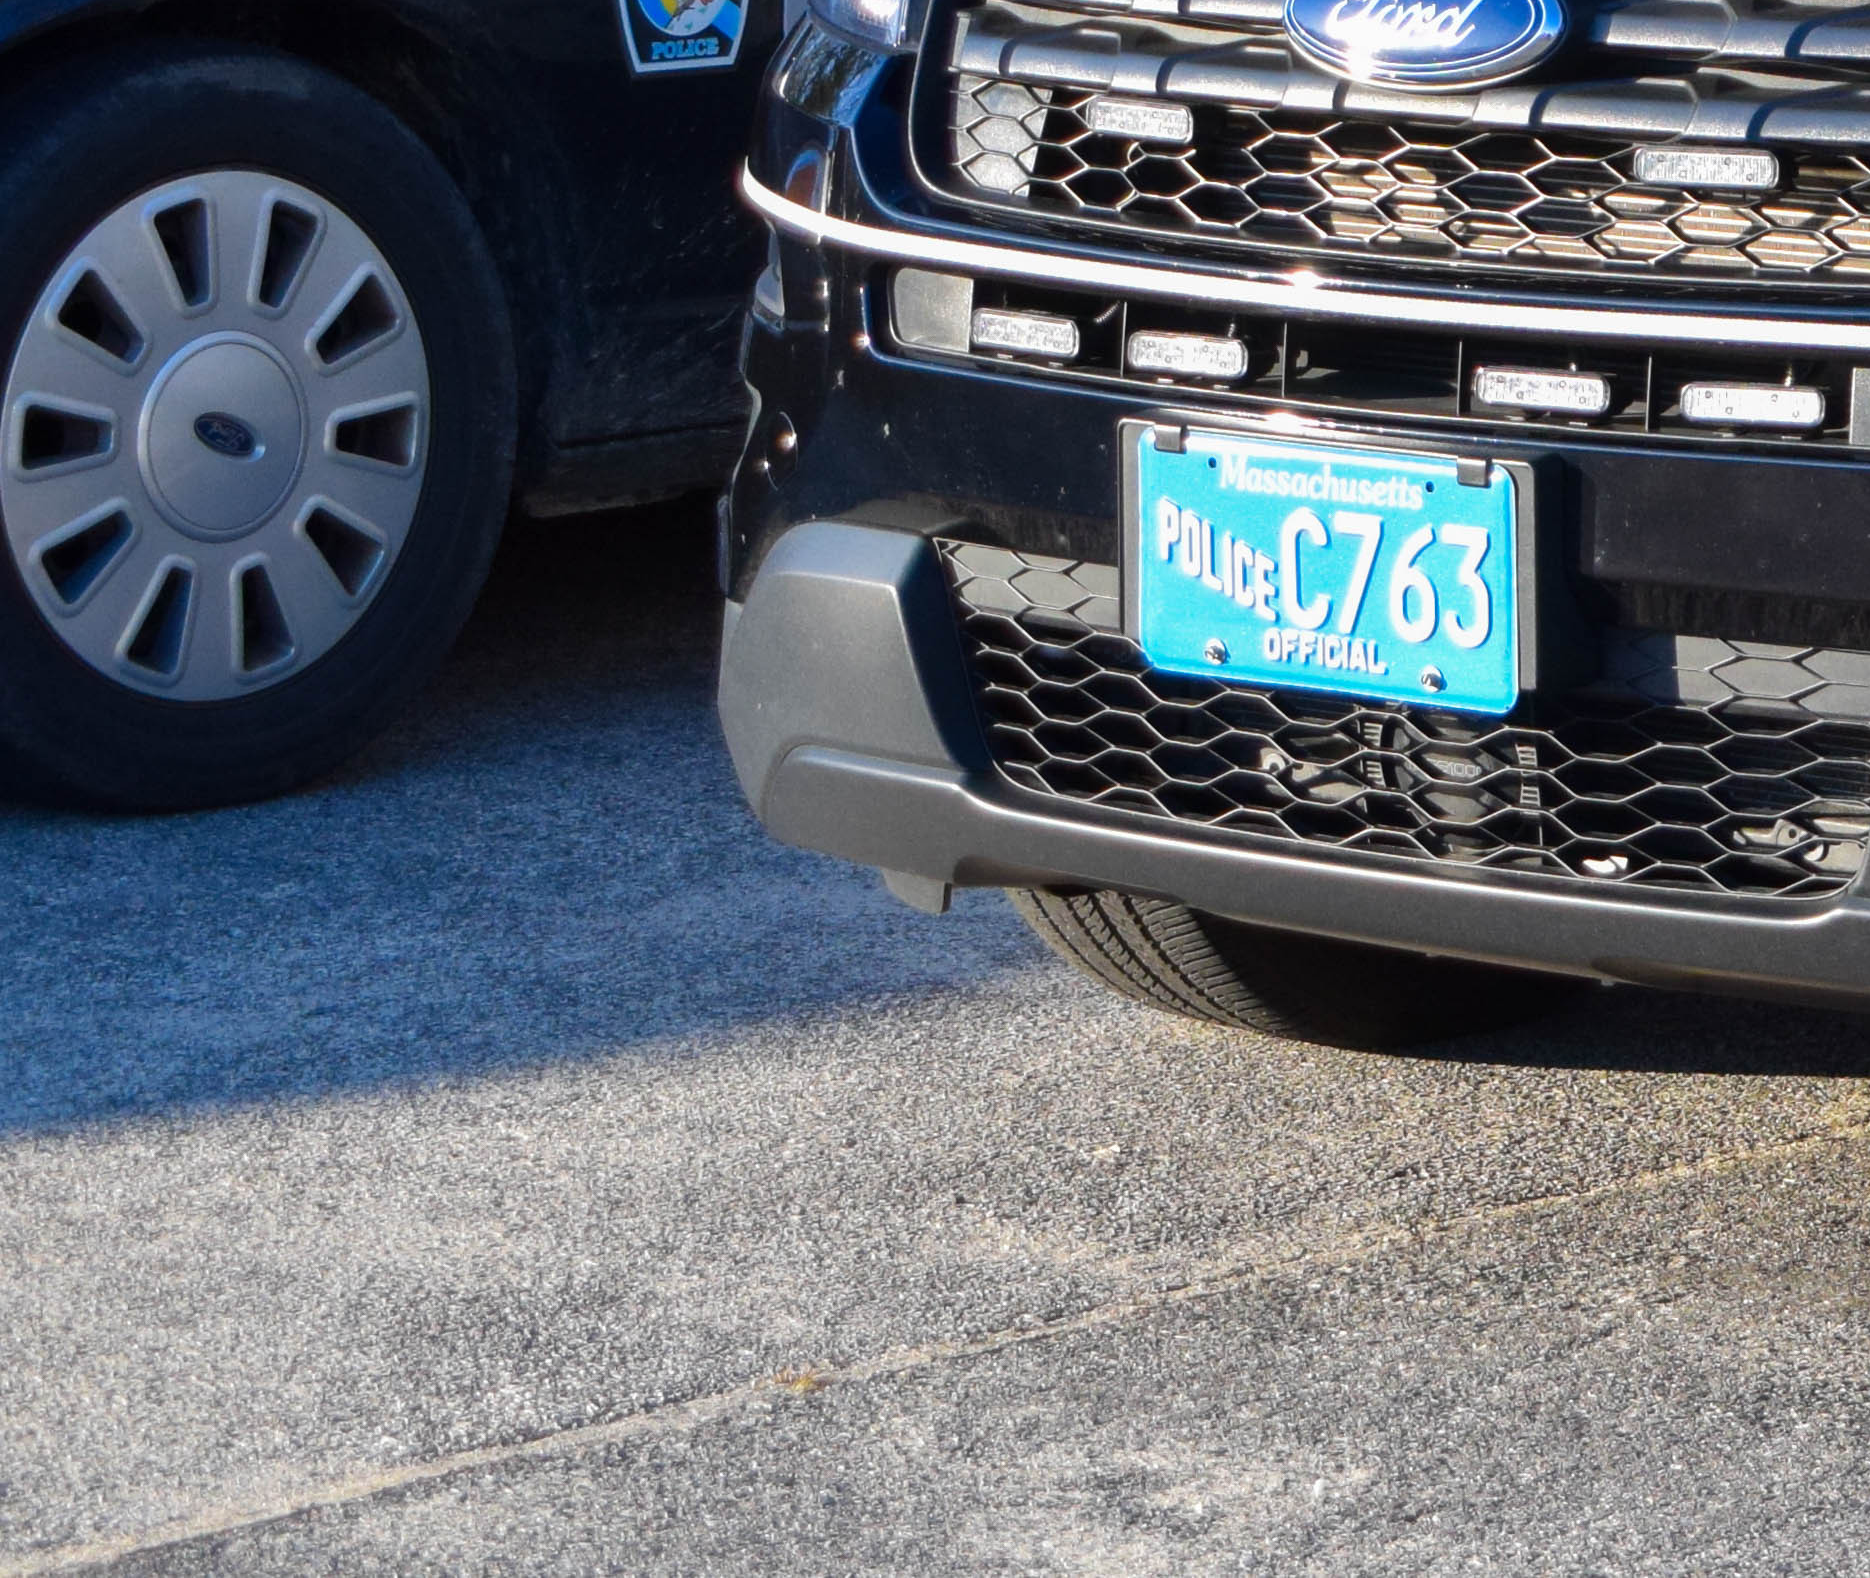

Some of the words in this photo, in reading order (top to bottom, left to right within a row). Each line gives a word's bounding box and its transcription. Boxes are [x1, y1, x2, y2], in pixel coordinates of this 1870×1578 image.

[651, 37, 719, 60] POLICE
[1218, 452, 1425, 510] Massachusetts
[1156, 495, 1280, 622] POLICE
[1280, 506, 1492, 649] C763
[1262, 627, 1389, 675] OFFICIAL
